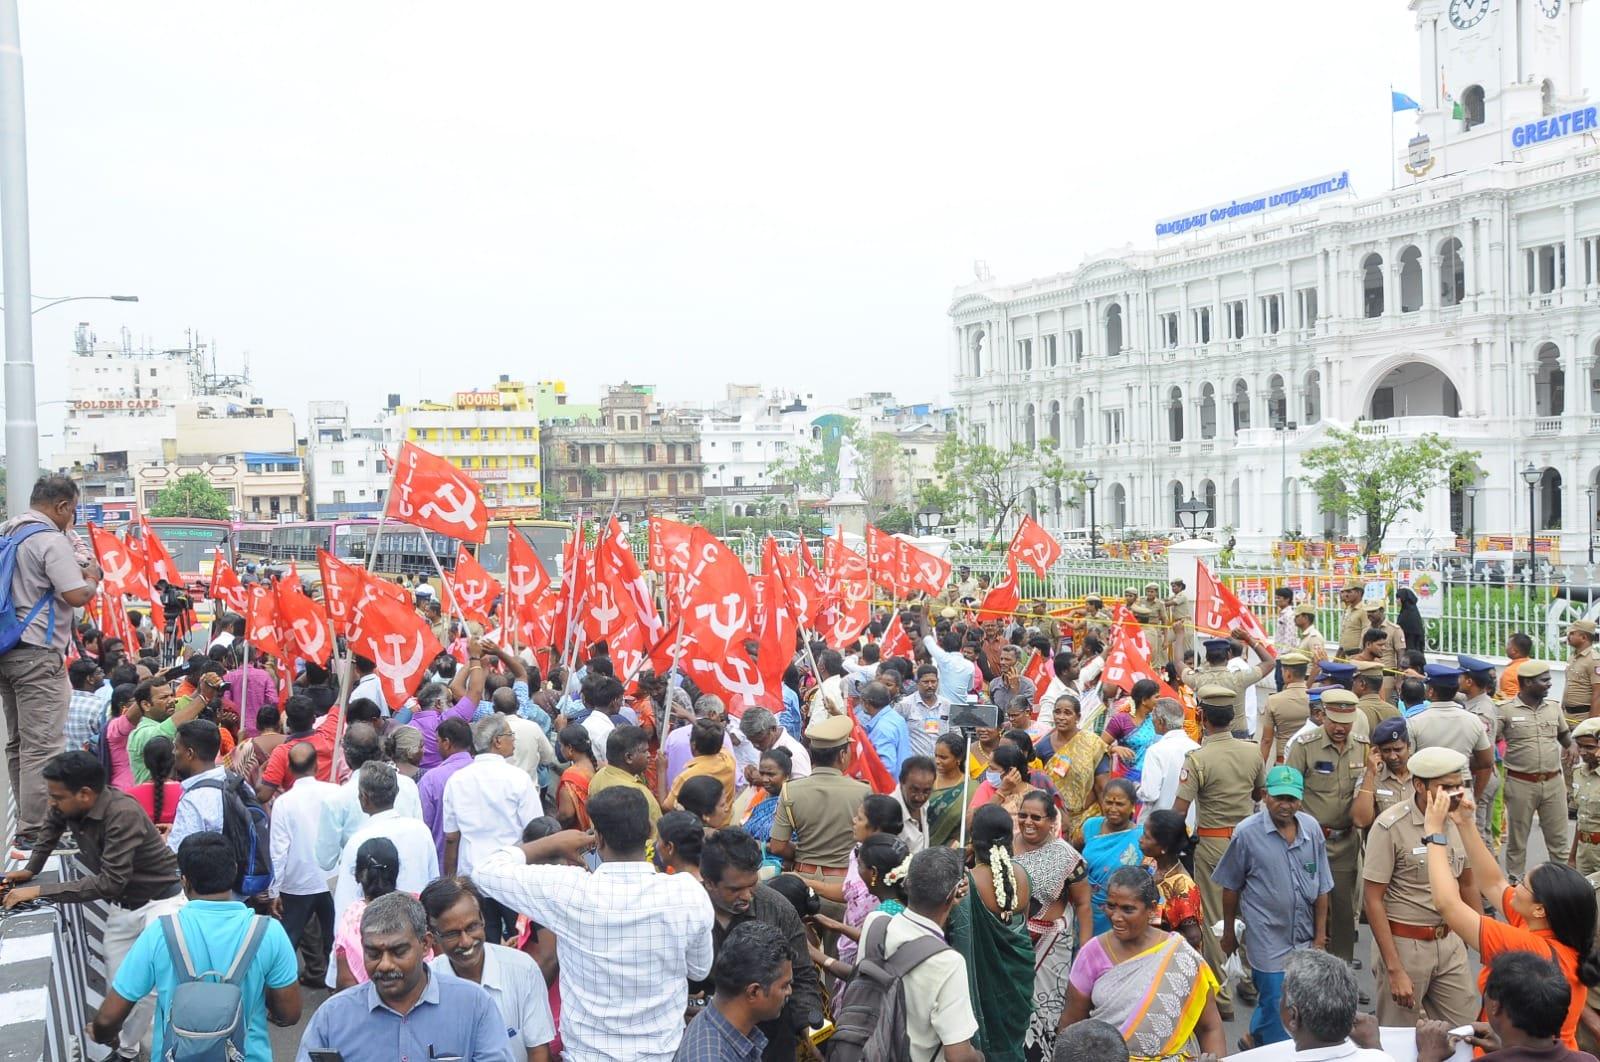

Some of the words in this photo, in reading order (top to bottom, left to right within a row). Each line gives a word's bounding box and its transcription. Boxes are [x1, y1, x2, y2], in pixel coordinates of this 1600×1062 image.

[1512, 106, 1598, 148] GREATER
[1155, 213, 1207, 236] பெருநகர
[1210, 199, 1266, 222] சென்னை
[1269, 171, 1349, 207] மாநகராட்சி
[73, 400, 123, 409] GOLDEN
[127, 400, 159, 409] CAFE
[458, 393, 499, 406] ROOMS
[399, 451, 418, 517] CITU
[653, 522, 666, 567] CITU
[899, 542, 911, 583] CITU
[679, 543, 719, 609] CITU
[344, 583, 378, 642] CITU
[754, 581, 765, 625] CITU
